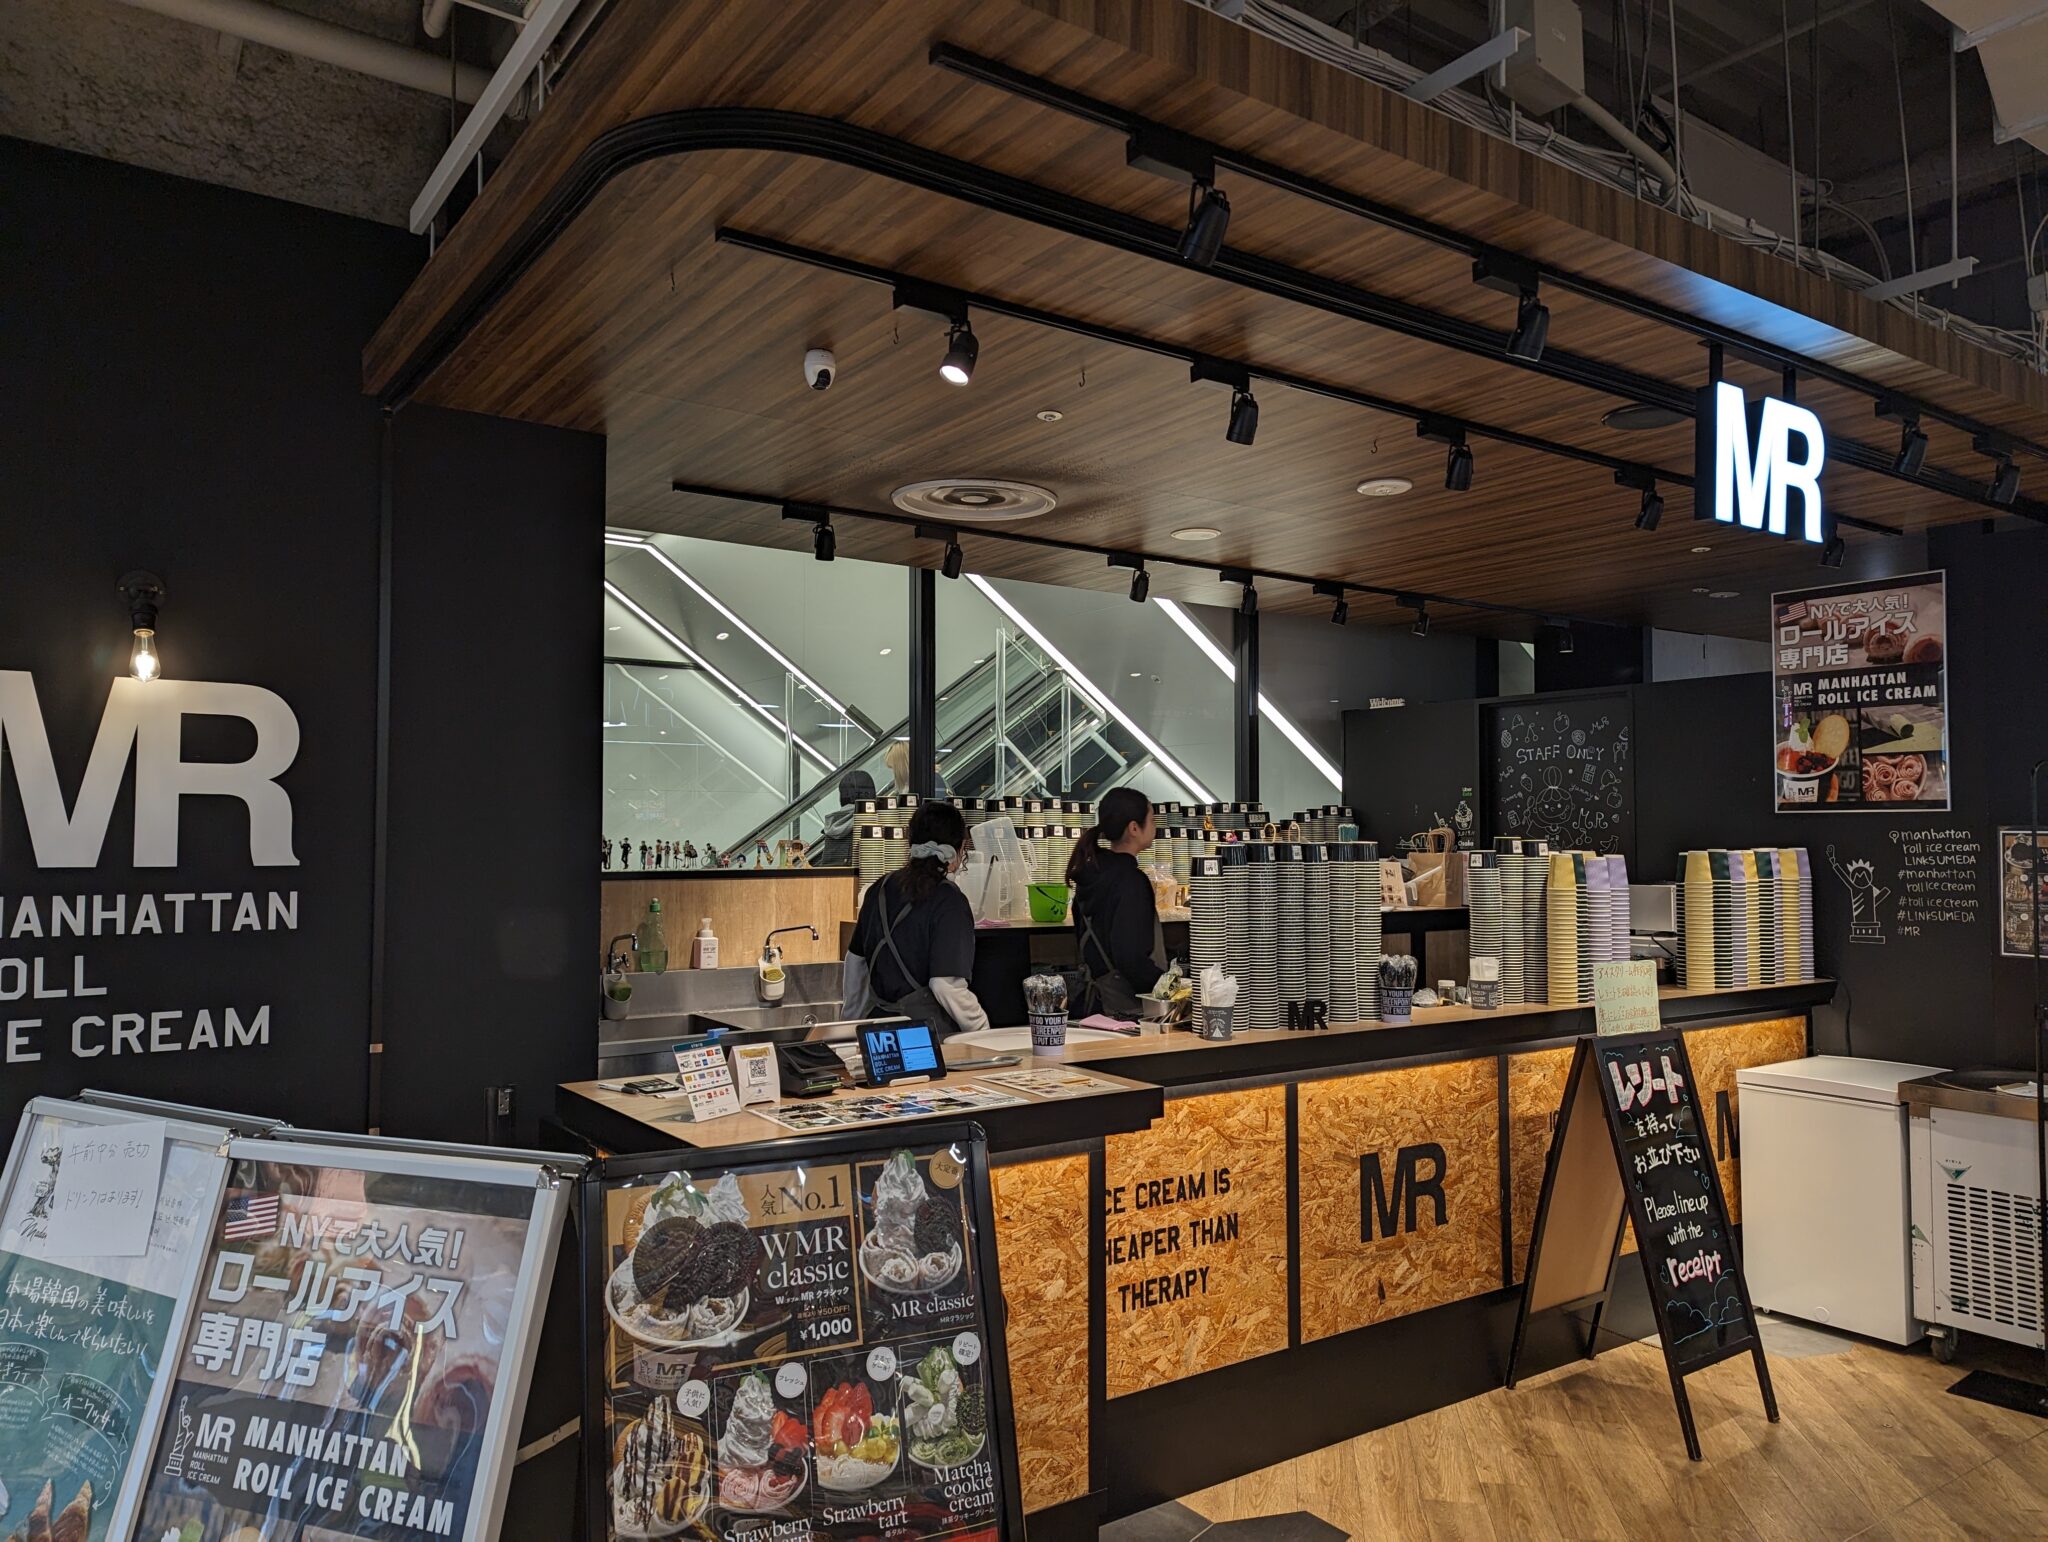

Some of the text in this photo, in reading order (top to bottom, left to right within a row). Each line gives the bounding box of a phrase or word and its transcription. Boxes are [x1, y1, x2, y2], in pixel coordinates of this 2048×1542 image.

[1715, 381, 1825, 543] MR
[1780, 611, 1917, 646] ロールアイス
[1779, 643, 1849, 670] 専門店
[1793, 682, 1813, 696] MR
[1818, 671, 1907, 691] MANHATTAN
[1818, 693, 1851, 706] ROLL
[1857, 689, 1878, 703] ICE
[1885, 684, 1937, 700] CREAM
[1516, 745, 1604, 764] STAFF ONLY
[0, 670, 300, 868] MR
[1798, 787, 1815, 796] MR
[1903, 843, 1980, 854] roll ice cream
[1898, 868, 1976, 880] #manhattan
[1906, 882, 1924, 892] roll
[0, 890, 299, 939] ANHATTAN
[1389, 989, 1404, 997] YOUR
[1044, 1016, 1062, 1025] YOUR
[1288, 1000, 1329, 1031] MR
[71, 1005, 270, 1059] CREAM
[867, 1032, 898, 1054] MR
[1608, 1056, 1684, 1112] レシート
[1635, 1112, 1676, 1137] を持って
[1634, 1142, 1701, 1174] お並び下さい
[778, 1175, 845, 1215] No.1
[1135, 1172, 1205, 1210] CREAM
[1213, 1168, 1231, 1195] IS
[1360, 1142, 1448, 1243] MR
[1644, 1196, 1677, 1223] Please
[280, 1212, 464, 1269] NYで大人気!
[1189, 1212, 1239, 1248] THAN
[1667, 1220, 1704, 1246] with the
[767, 1255, 849, 1289] classic
[1666, 1249, 1721, 1288] receipt
[208, 1250, 464, 1339] ロールアイス
[1118, 1265, 1211, 1313] THERAPY
[891, 1293, 975, 1319] MR classic
[800, 1318, 852, 1341] ¥1,000
[191, 1311, 327, 1387] 専門店
[656, 1363, 688, 1376] MR
[779, 1375, 804, 1386] フレッシュ
[195, 1413, 236, 1453] MR
[192, 1450, 228, 1464] MANHATTAN
[243, 1416, 409, 1478] MANHATTAN
[186, 1471, 221, 1485] ICE CREAM
[189, 1460, 205, 1471] ROLL
[933, 1459, 992, 1485] Matcha
[232, 1458, 454, 1536] ROLL ICE CREAM
[944, 1473, 993, 1498] cookie
[823, 1495, 907, 1526] Strawberry
[949, 1491, 995, 1513] cream
[724, 1517, 813, 1542] Strawberry
[879, 1511, 908, 1529] tart
